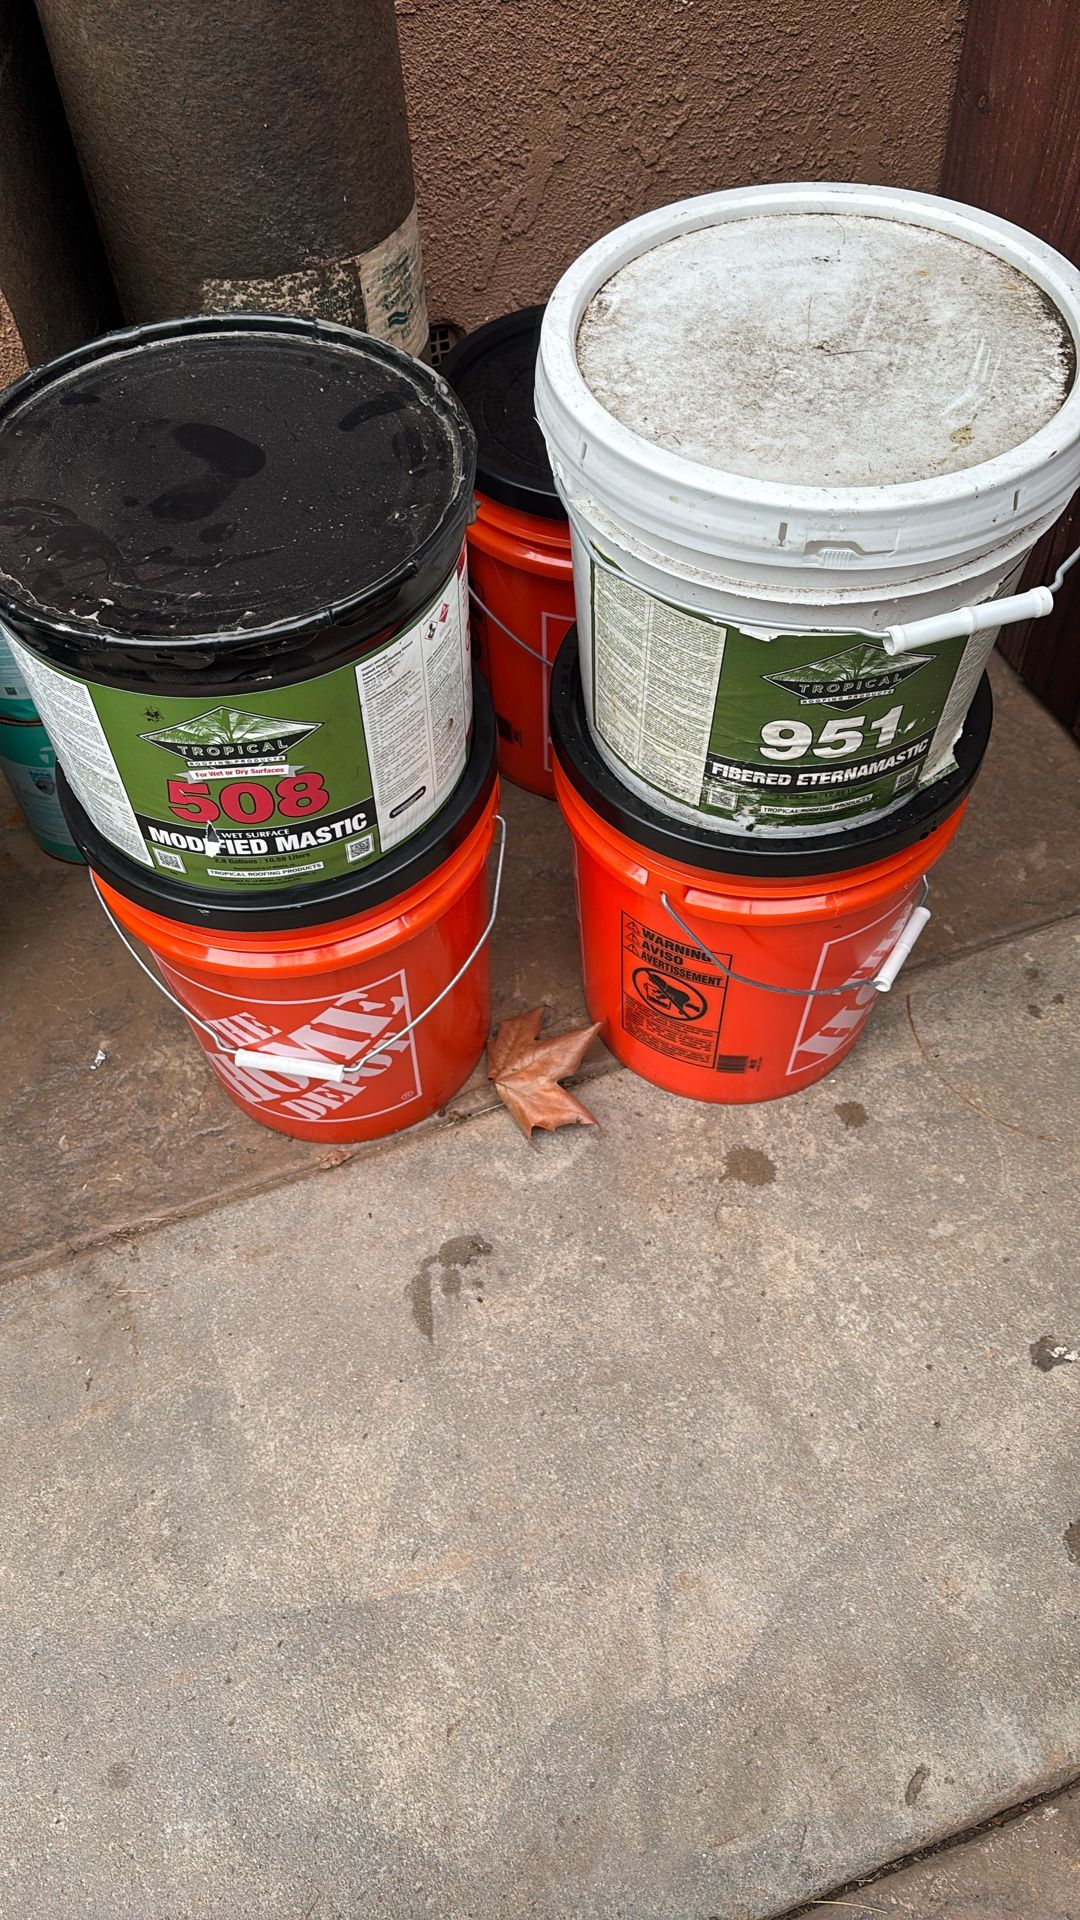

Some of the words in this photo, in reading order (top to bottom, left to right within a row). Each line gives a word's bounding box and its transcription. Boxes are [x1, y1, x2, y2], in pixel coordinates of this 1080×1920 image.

[799, 673, 902, 693] TROPICAL
[802, 696, 843, 704] ROOFING
[847, 690, 893, 699] PRODUCTS
[177, 739, 289, 757] TROPICAL
[759, 704, 904, 761] 951
[711, 761, 792, 786] FIBERED
[796, 738, 929, 786] ETERNAMASTIC
[167, 772, 330, 825] 508
[834, 796, 870, 809] PRODUCTS
[246, 828, 290, 838] SURFACE
[277, 812, 368, 852] MASTIC
[282, 863, 322, 874] PRODUCTS
[641, 941, 684, 965] AVISO
[642, 928, 712, 962] WARNING
[641, 951, 723, 986] AVERTISSEMENT
[205, 1011, 283, 1049] THE
[207, 991, 405, 1104] HOME
